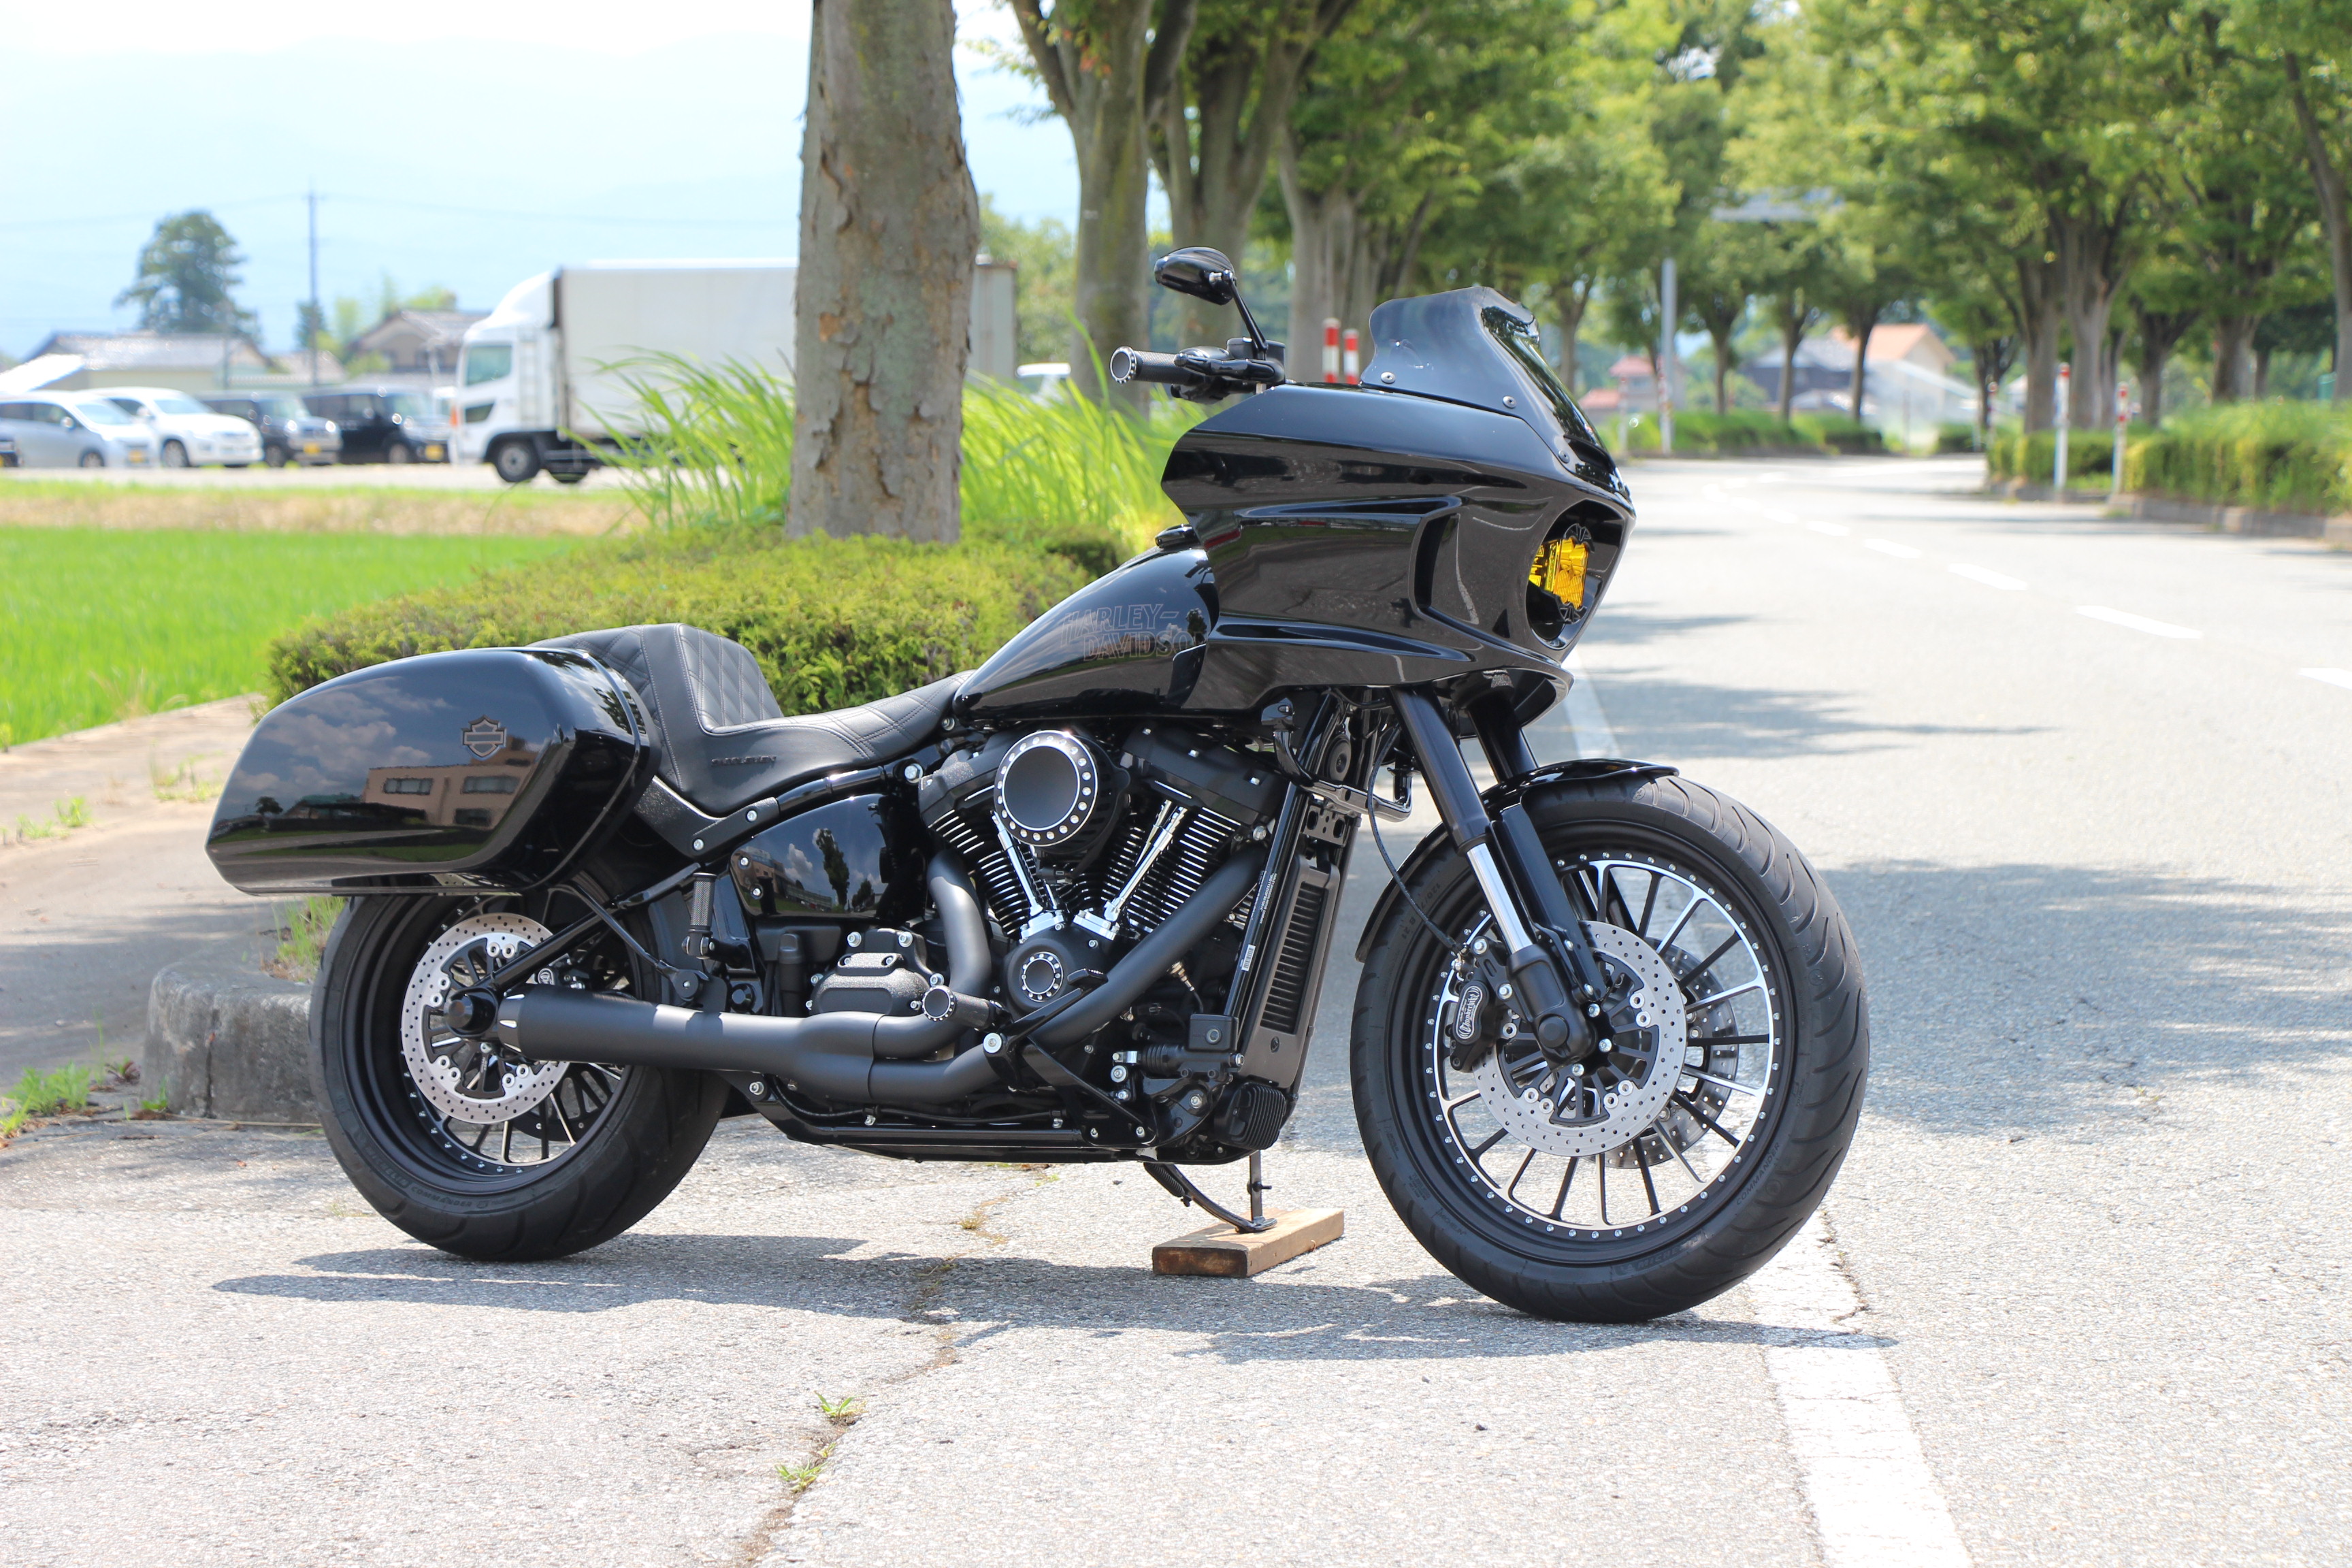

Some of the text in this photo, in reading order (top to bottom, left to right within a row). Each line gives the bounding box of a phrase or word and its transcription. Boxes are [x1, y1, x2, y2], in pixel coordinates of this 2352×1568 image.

[1060, 604, 1179, 647] HARLEY-
[1083, 631, 1207, 662] DAVIDSO
[1735, 1141, 1780, 1206] COMMANDER
[410, 1186, 472, 1207] COMMANDER
